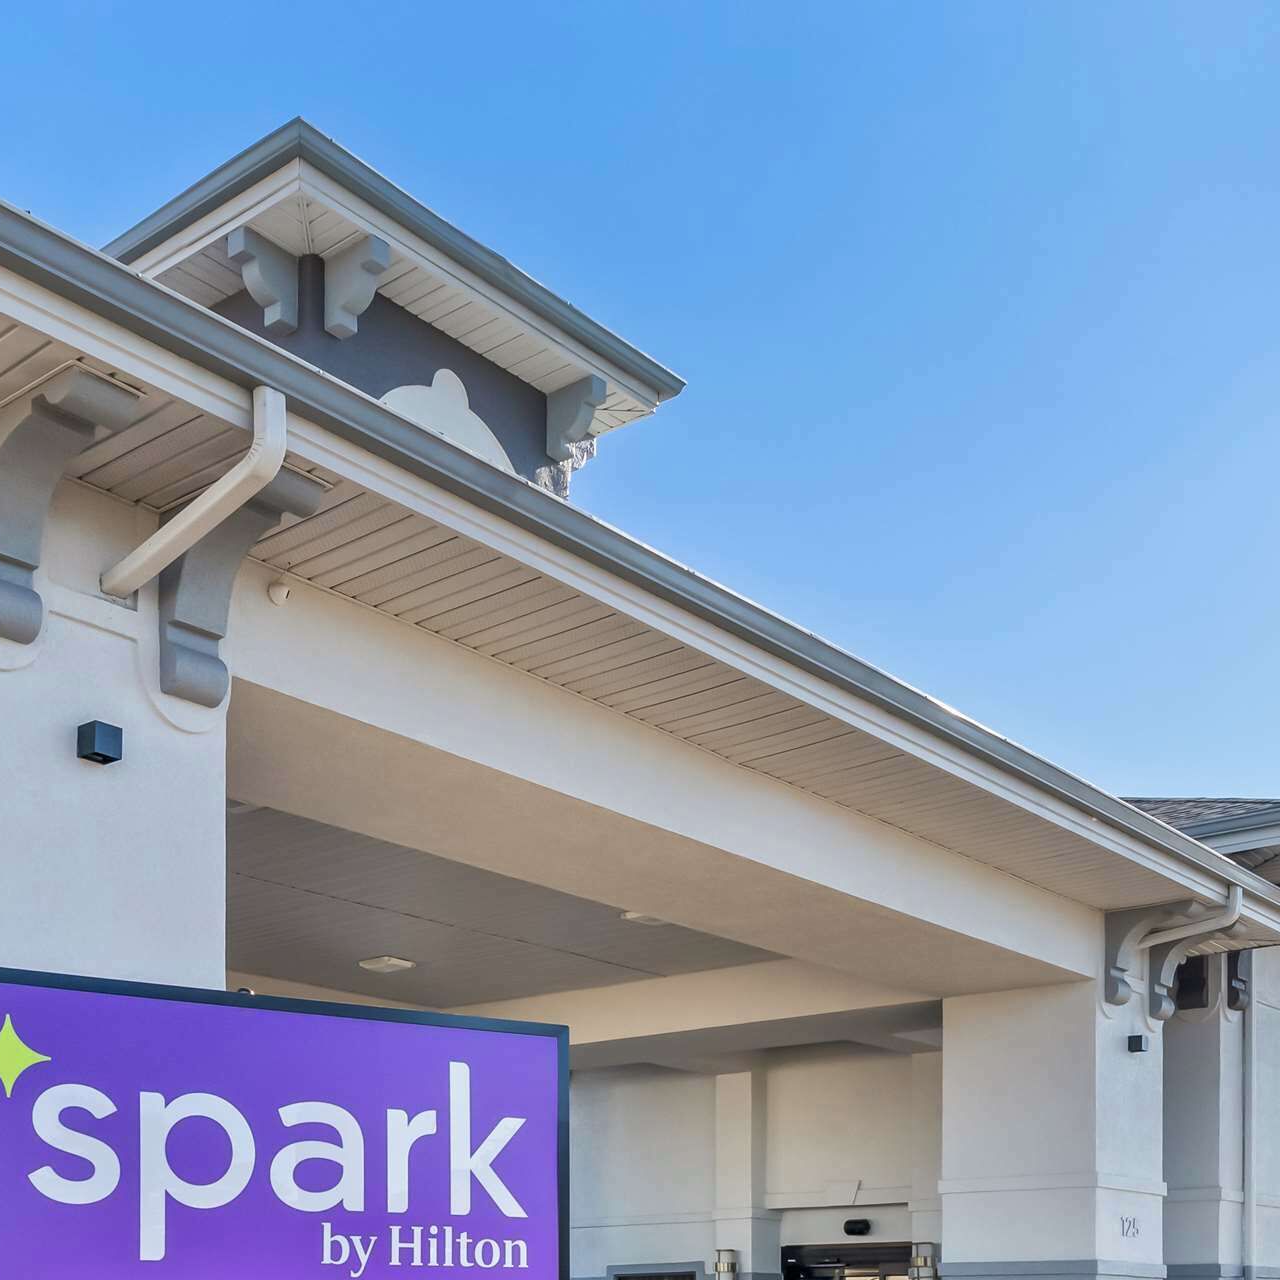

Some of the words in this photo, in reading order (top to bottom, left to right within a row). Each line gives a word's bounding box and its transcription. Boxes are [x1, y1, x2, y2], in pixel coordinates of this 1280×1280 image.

[27, 1061, 529, 1261] spark
[321, 1222, 378, 1278] by
[389, 1225, 529, 1268] Hilton
